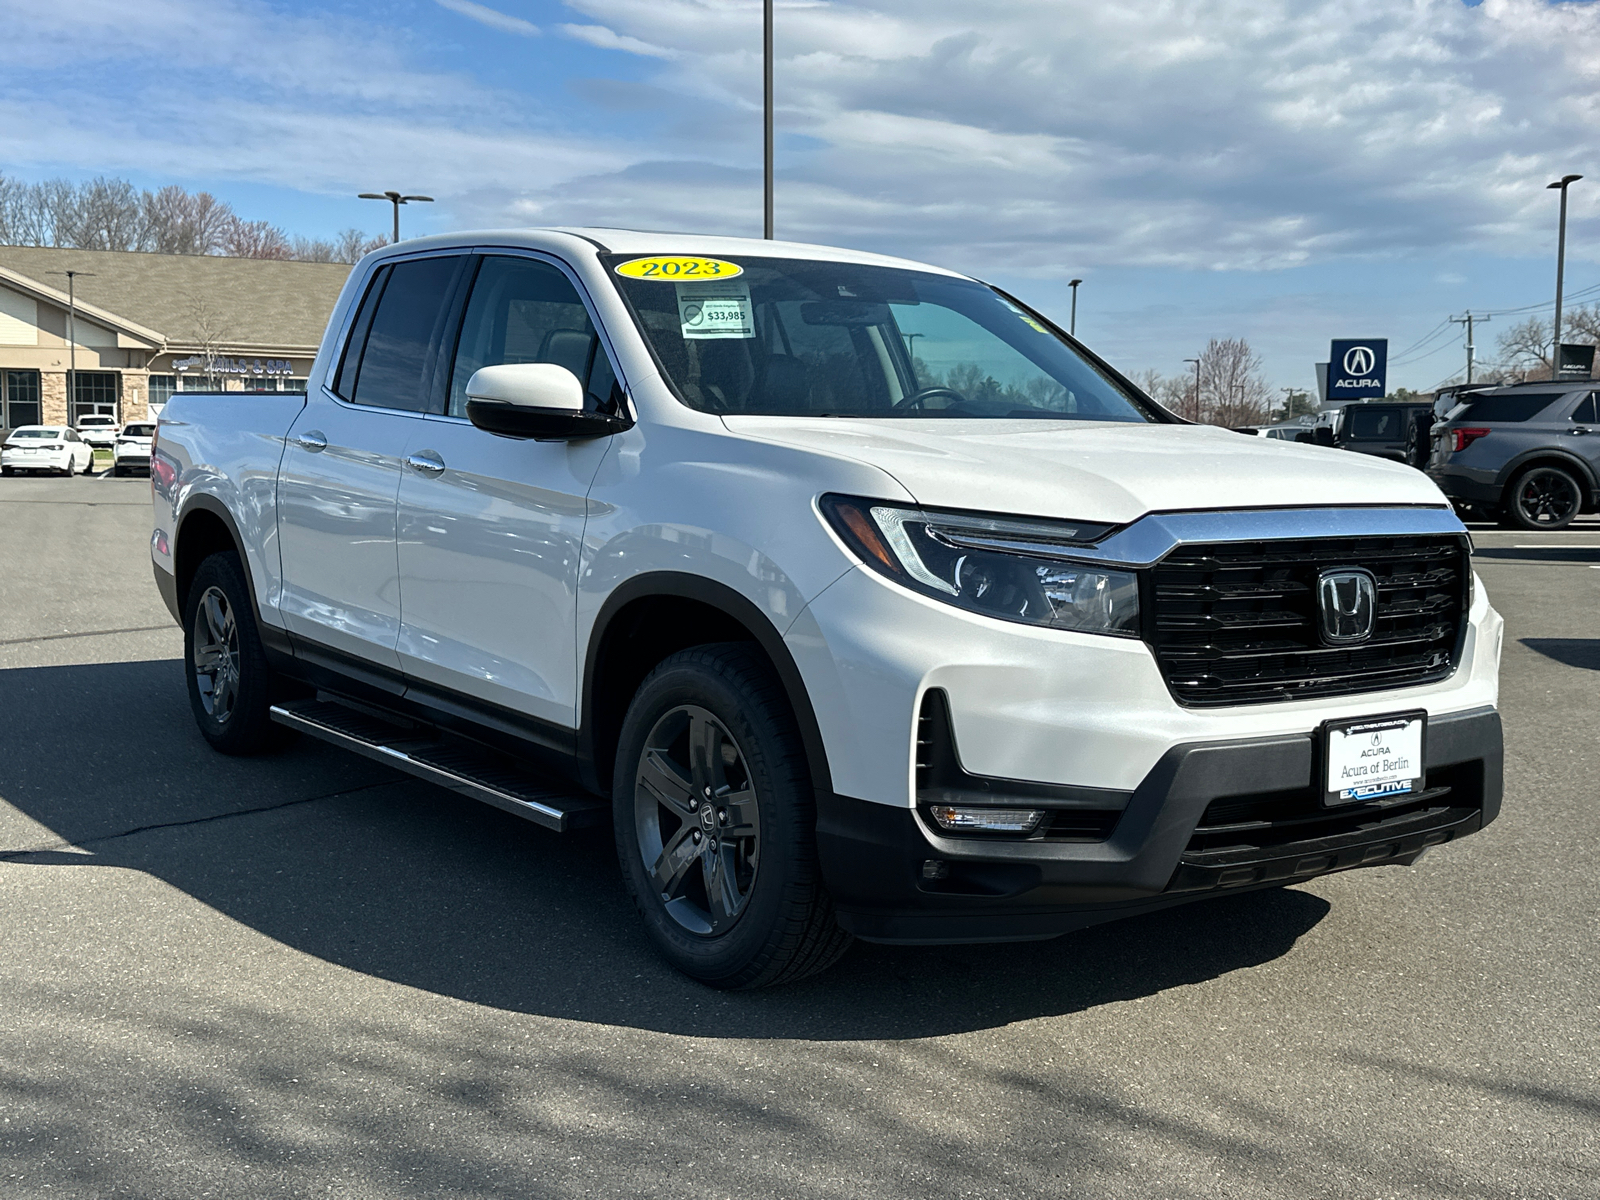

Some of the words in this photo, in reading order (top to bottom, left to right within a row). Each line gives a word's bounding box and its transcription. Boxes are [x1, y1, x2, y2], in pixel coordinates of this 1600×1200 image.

[642, 262, 721, 276] 2023
[707, 311, 746, 322] $33,985
[252, 359, 264, 374] &
[266, 360, 294, 375] SPA
[1335, 378, 1382, 388] ACURA
[1360, 746, 1391, 758] ACURA
[1341, 765, 1368, 779] Acura
[1370, 761, 1380, 774] of
[1382, 757, 1409, 772] Berlin
[1340, 779, 1412, 800] EXECUTIVE
